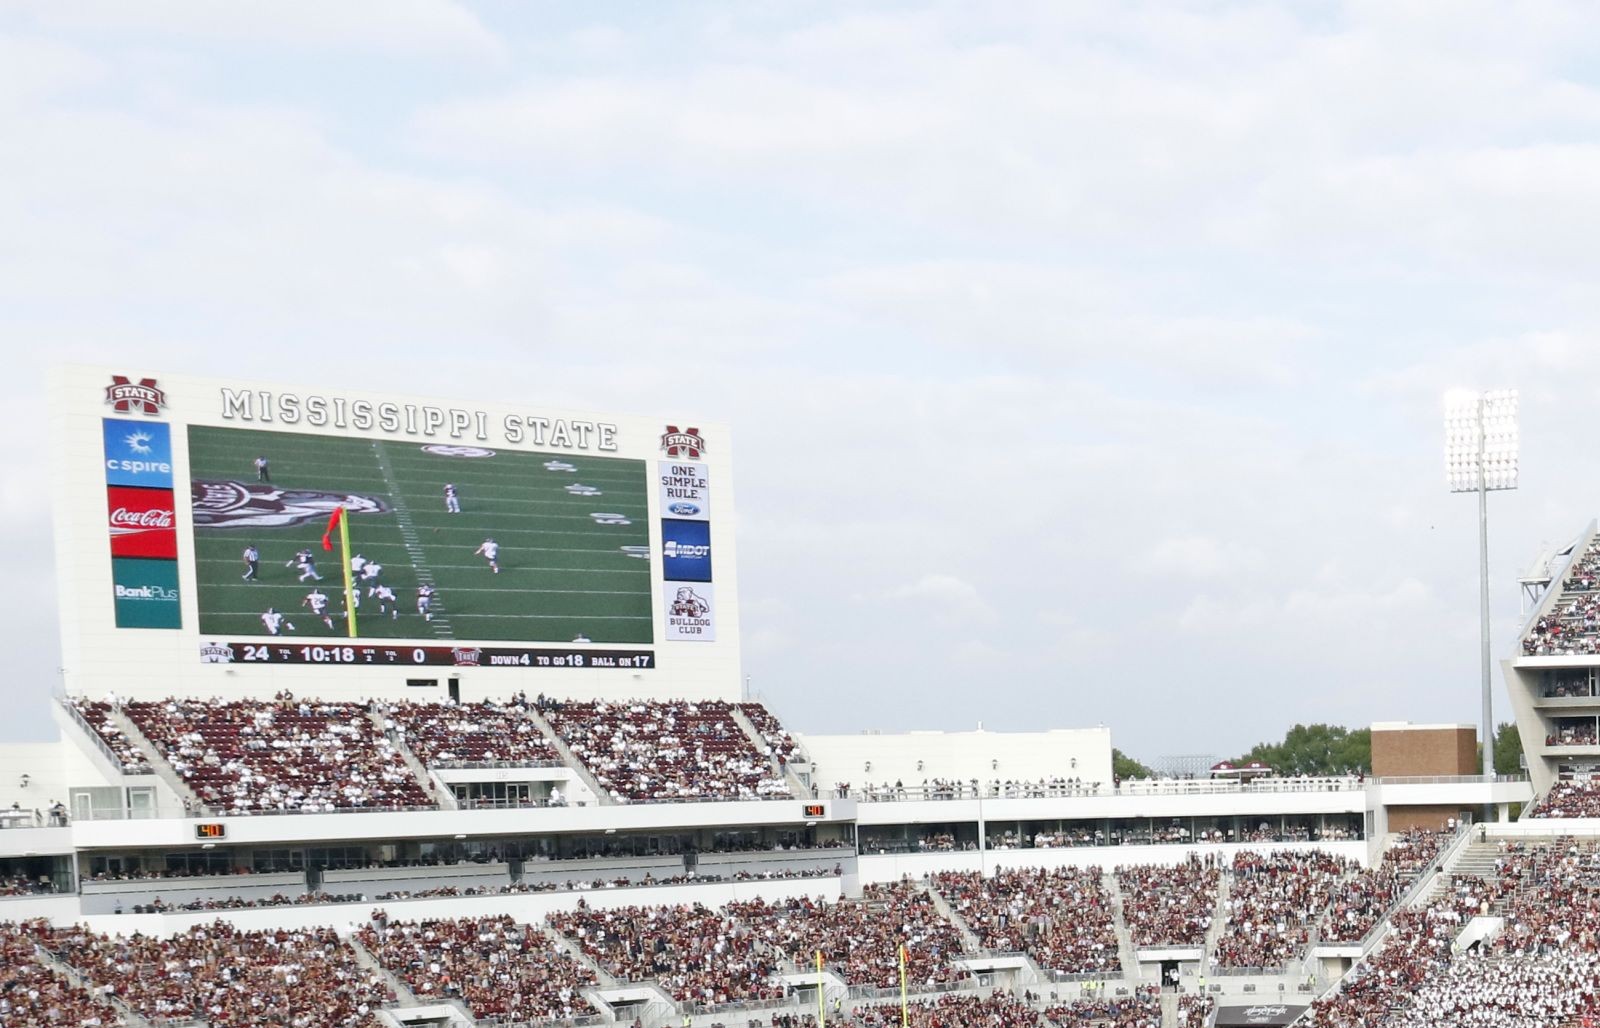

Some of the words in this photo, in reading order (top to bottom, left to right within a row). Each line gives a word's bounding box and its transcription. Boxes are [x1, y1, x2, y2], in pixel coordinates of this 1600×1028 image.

[115, 386, 156, 402] STATE
[221, 387, 488, 440] MISSISSIPPI
[504, 414, 618, 451] STATE
[667, 435, 698, 448] STATE
[121, 460, 171, 474] spire
[671, 465, 696, 477] ONE
[661, 476, 706, 489] SIMPLE
[676, 544, 709, 556] MDOT
[115, 584, 178, 599] BankPlus
[670, 617, 711, 627] BULLDOG
[679, 626, 702, 635] CLUB
[243, 646, 269, 661] 24
[301, 647, 354, 662] 10:18
[412, 649, 426, 663] 0
[491, 655, 519, 665] DOWN
[520, 653, 530, 665] 4
[537, 656, 550, 666] TO
[553, 656, 565, 666] GO
[566, 655, 583, 667] 18
[591, 657, 615, 667] BALL
[619, 657, 632, 667] ON
[633, 656, 650, 668] 17
